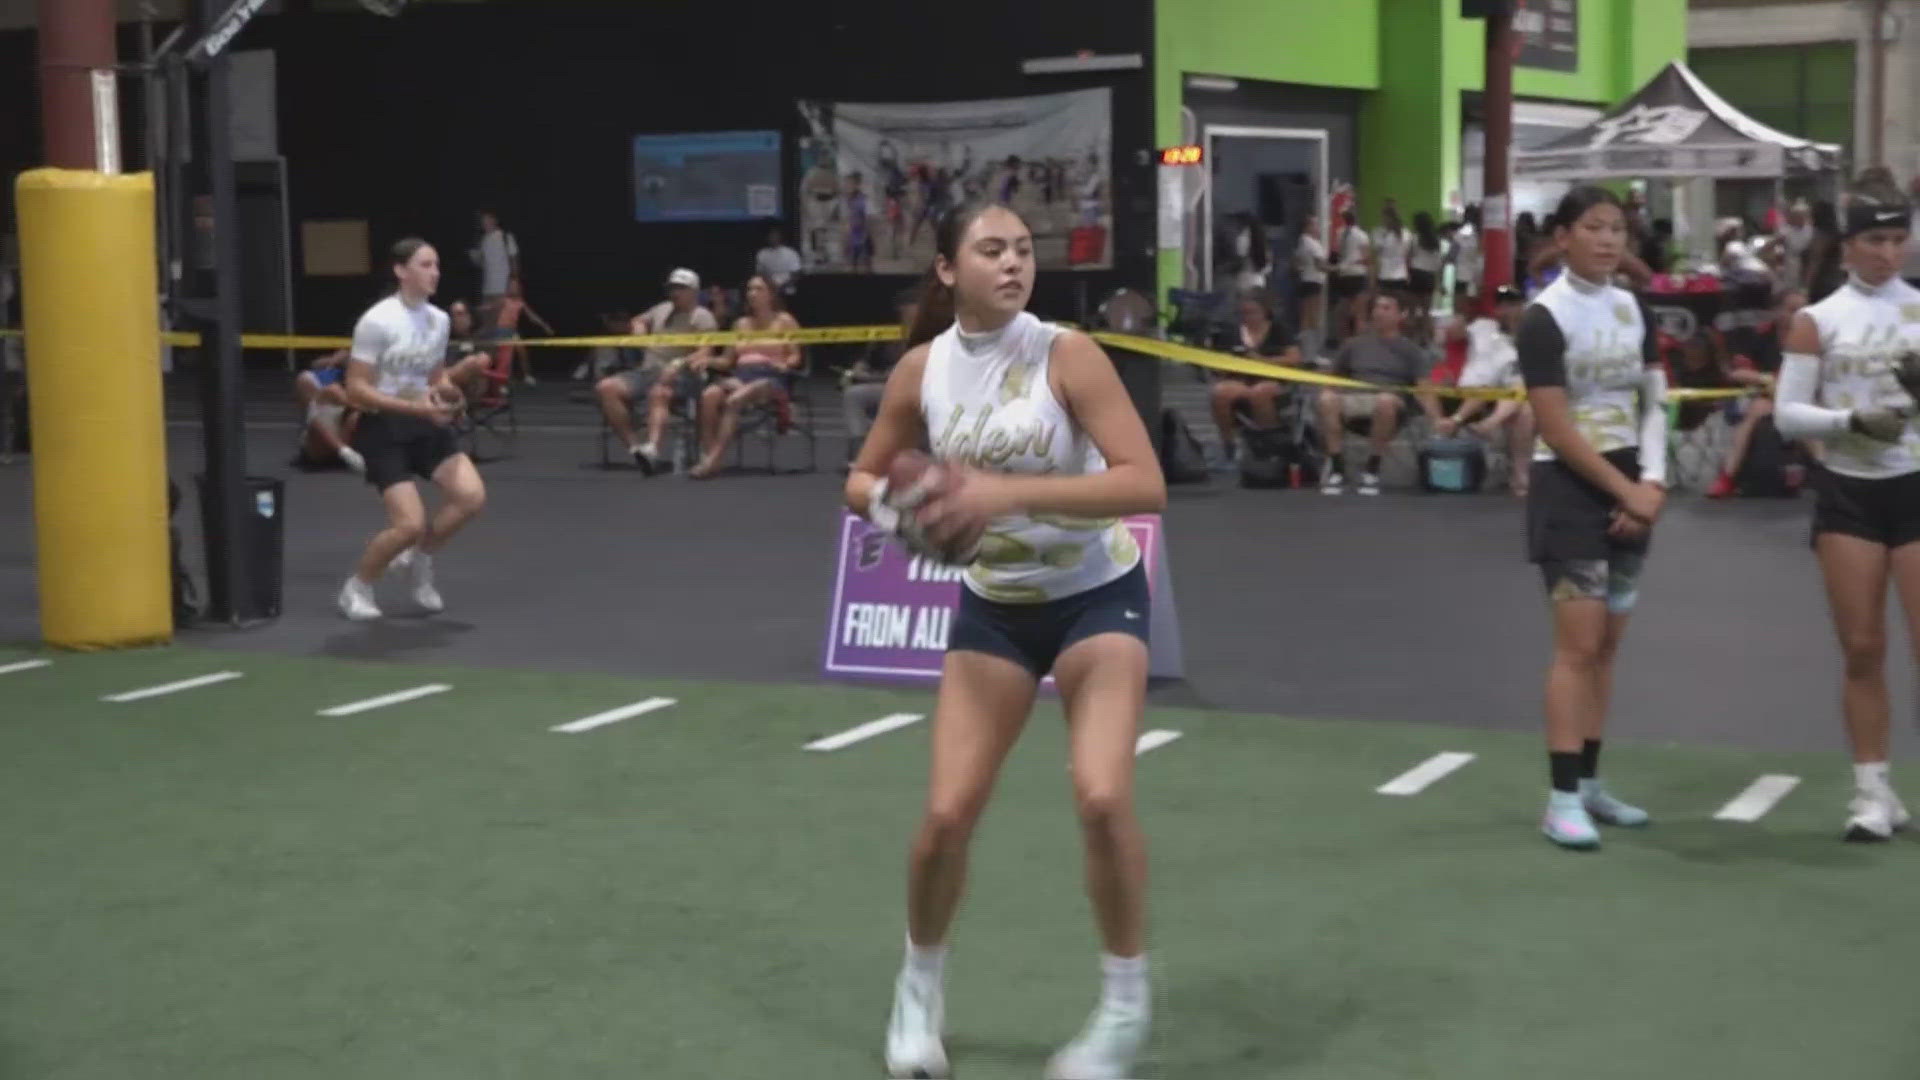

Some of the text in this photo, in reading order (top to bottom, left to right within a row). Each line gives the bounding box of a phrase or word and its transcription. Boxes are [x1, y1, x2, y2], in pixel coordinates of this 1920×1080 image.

[935, 402, 1057, 467] lden
[843, 603, 951, 649] FROM ALL
